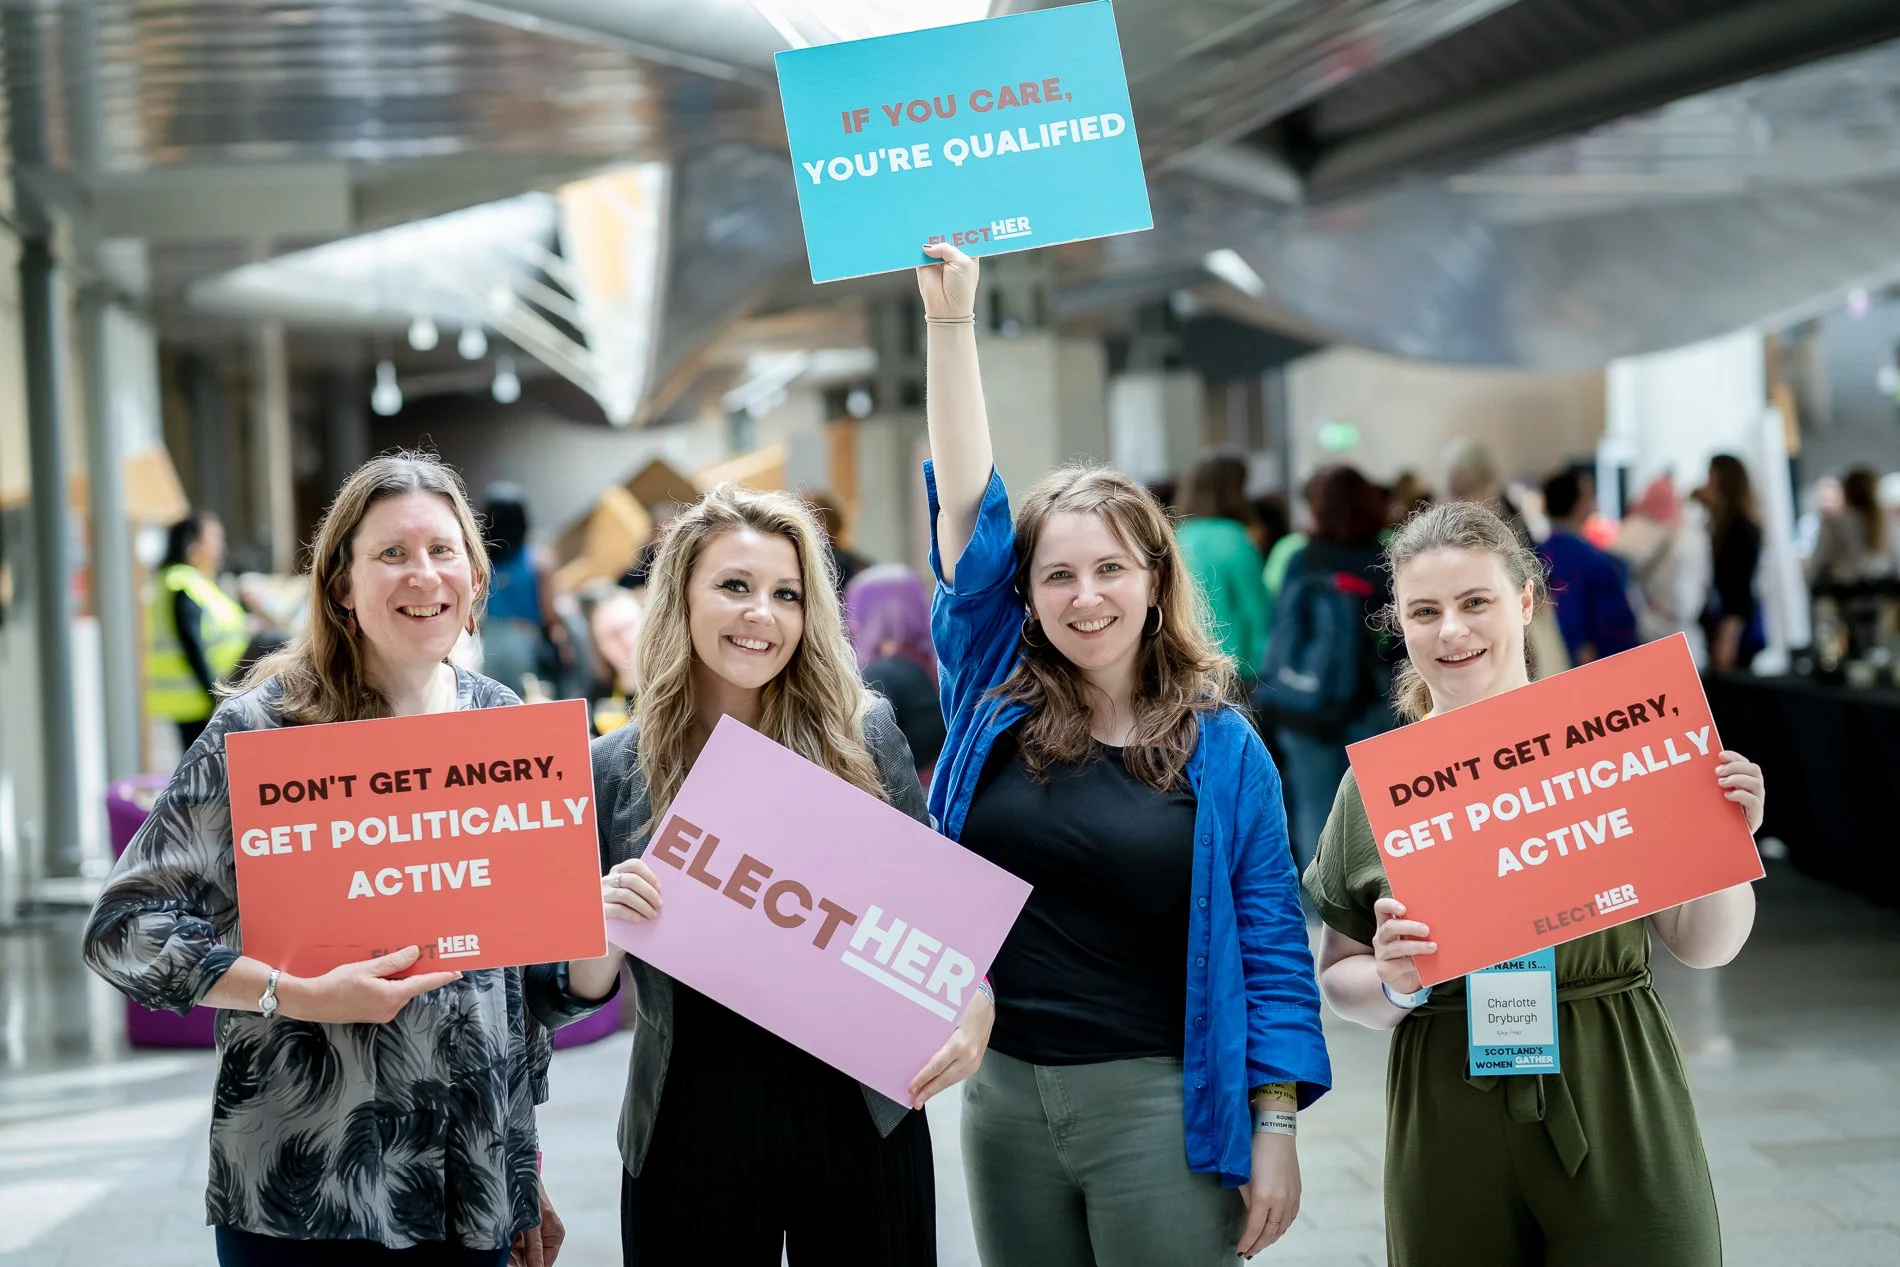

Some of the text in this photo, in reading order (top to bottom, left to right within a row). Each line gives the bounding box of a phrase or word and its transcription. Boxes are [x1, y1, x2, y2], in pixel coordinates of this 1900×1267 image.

[841, 77, 1072, 134] IF YOU CARE,
[802, 113, 1126, 185] YOU'RE QUALIFIED
[1388, 694, 1679, 807] DON'T GET ANGRY,
[258, 756, 563, 806] DON'T GET ANGRY,
[1383, 725, 1711, 858] GET POLITICALLY
[240, 797, 589, 857] GET POLITICALLY
[1497, 807, 1633, 877] ACTIVE
[347, 859, 491, 899] ACTIVE
[1494, 960, 1525, 970] NAME
[1487, 998, 1536, 1008] Charlotte
[1488, 1013, 1537, 1025] Dryburgh
[1475, 1055, 1554, 1069] WOMEN GATHER
[1484, 1046, 1543, 1056] SCOTLAND'S
